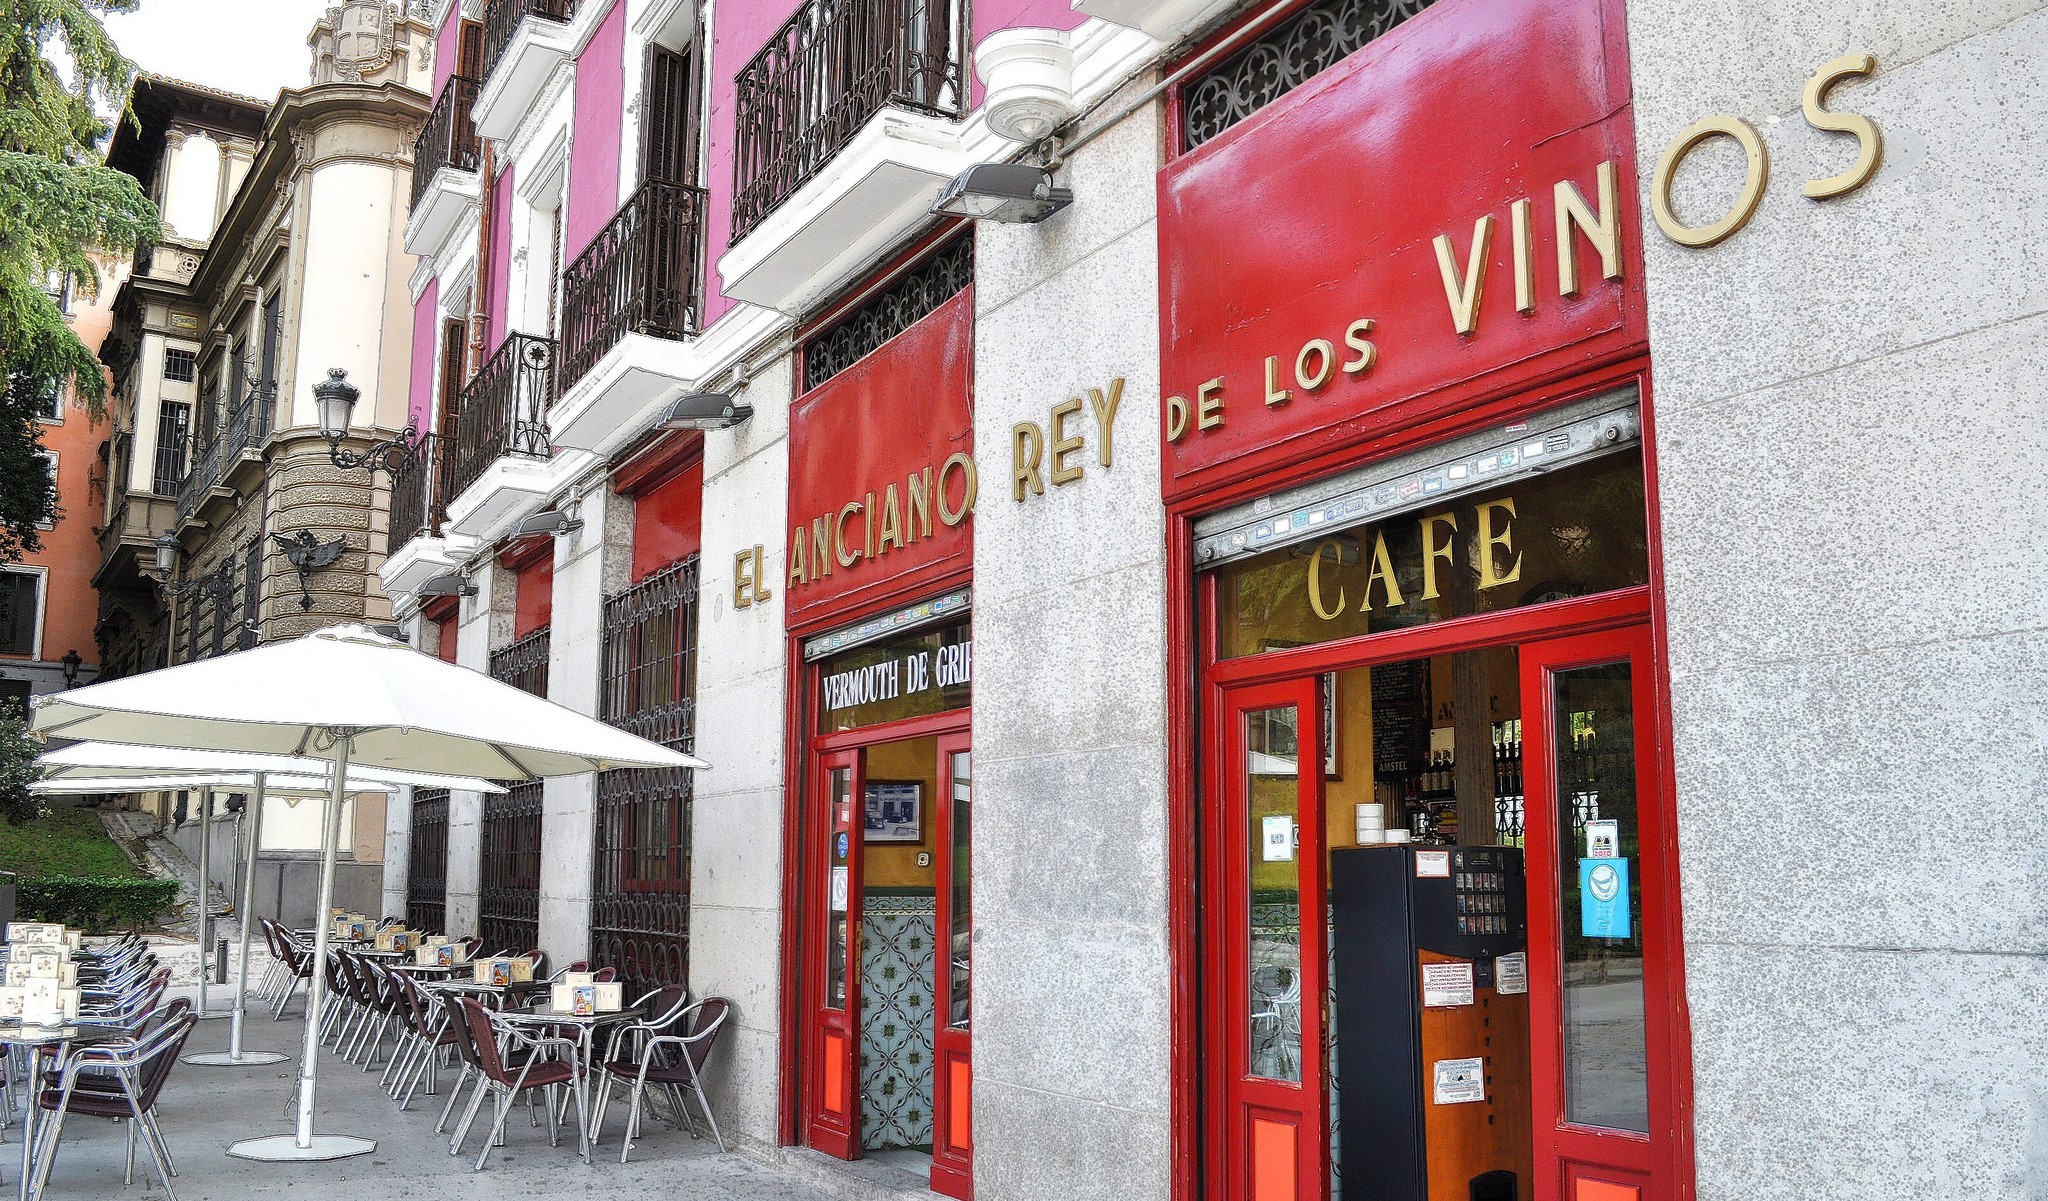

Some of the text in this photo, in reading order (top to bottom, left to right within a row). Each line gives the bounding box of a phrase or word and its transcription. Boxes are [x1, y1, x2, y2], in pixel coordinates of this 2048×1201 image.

[733, 53, 1885, 611] EL ANCIANO REY DE LOS VINOS
[1307, 497, 1523, 620] CAFE
[823, 659, 899, 713] VERMOUTH
[906, 651, 930, 694] DE
[1379, 761, 1408, 772] AMSTEL
